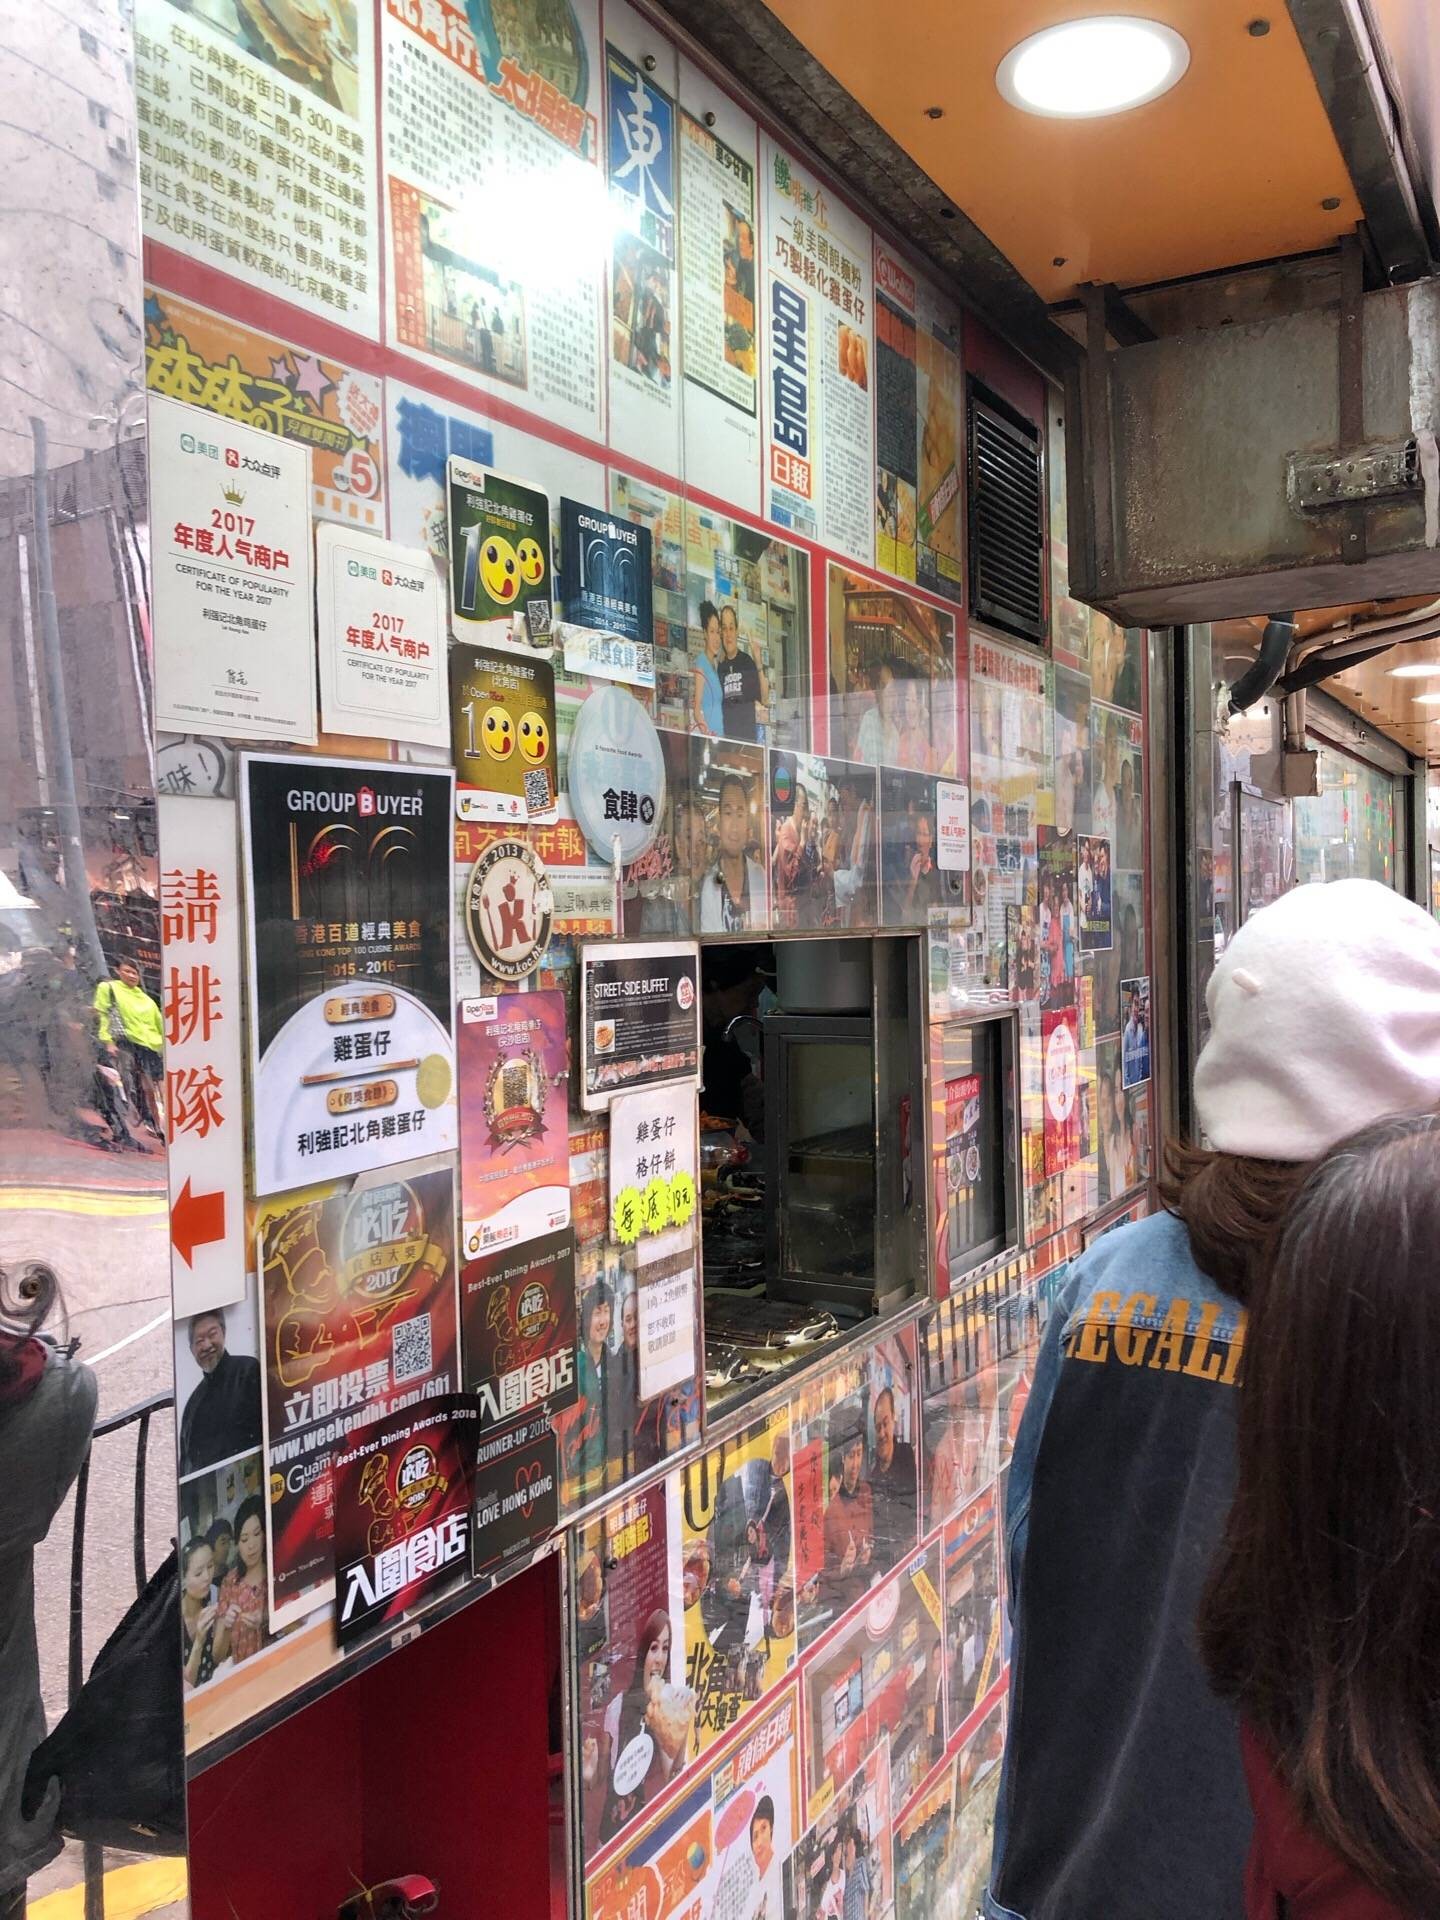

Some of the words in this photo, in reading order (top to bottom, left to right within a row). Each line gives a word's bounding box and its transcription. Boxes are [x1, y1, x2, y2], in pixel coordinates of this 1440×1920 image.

[612, 72, 675, 212] 東
[242, 456, 281, 479] 大众点评
[350, 453, 372, 496] 5
[773, 450, 809, 495] 日報
[212, 508, 255, 536] 2017
[174, 522, 289, 571] 年度人气商户
[175, 563, 226, 583] CERTIFICATE
[228, 576, 240, 586] OF
[243, 579, 289, 598] POPULARITY
[196, 580, 213, 592] FOR
[215, 585, 230, 597] THE
[234, 590, 254, 602] YEAR
[256, 595, 272, 606] 2017
[372, 612, 405, 633] 2017
[346, 626, 430, 660] 年度人气商户
[347, 659, 383, 672] CERTIFICATE
[385, 665, 393, 673] OF
[362, 671, 374, 680] FOR
[376, 674, 387, 683] THE
[492, 844, 518, 862] 2013
[337, 947, 352, 957] TOP
[366, 960, 396, 974] 2016
[491, 943, 543, 975] www.koc.hk
[594, 978, 640, 1000] STREET-SIDE
[641, 977, 669, 995] BUFFET
[161, 868, 225, 1144] 請排隊
[333, 1029, 391, 1063] 雞蛋仔
[297, 1110, 426, 1157] 利強記北角雞蛋仔
[352, 1198, 409, 1249] 必吃
[365, 1265, 401, 1292] 2017
[504, 1264, 528, 1282] Dining
[530, 1255, 555, 1272] Awards
[283, 1358, 390, 1434] 立即投票
[477, 1347, 573, 1422] 入圍食店
[337, 1435, 380, 1466] Best-Ever
[381, 1426, 410, 1449] Dining
[413, 1411, 448, 1433] Awards
[452, 1409, 477, 1421] 2018
[477, 1426, 529, 1466] RUNNER-UP
[530, 1418, 550, 1439] 2018
[286, 1454, 332, 1494] Guam
[402, 1459, 430, 1487] 必吃
[477, 1501, 500, 1529] LOVE
[502, 1490, 527, 1517] HONG
[529, 1476, 553, 1503] KONG
[342, 1513, 467, 1622] 入圍食店
[699, 1696, 741, 1732] 大搜查
